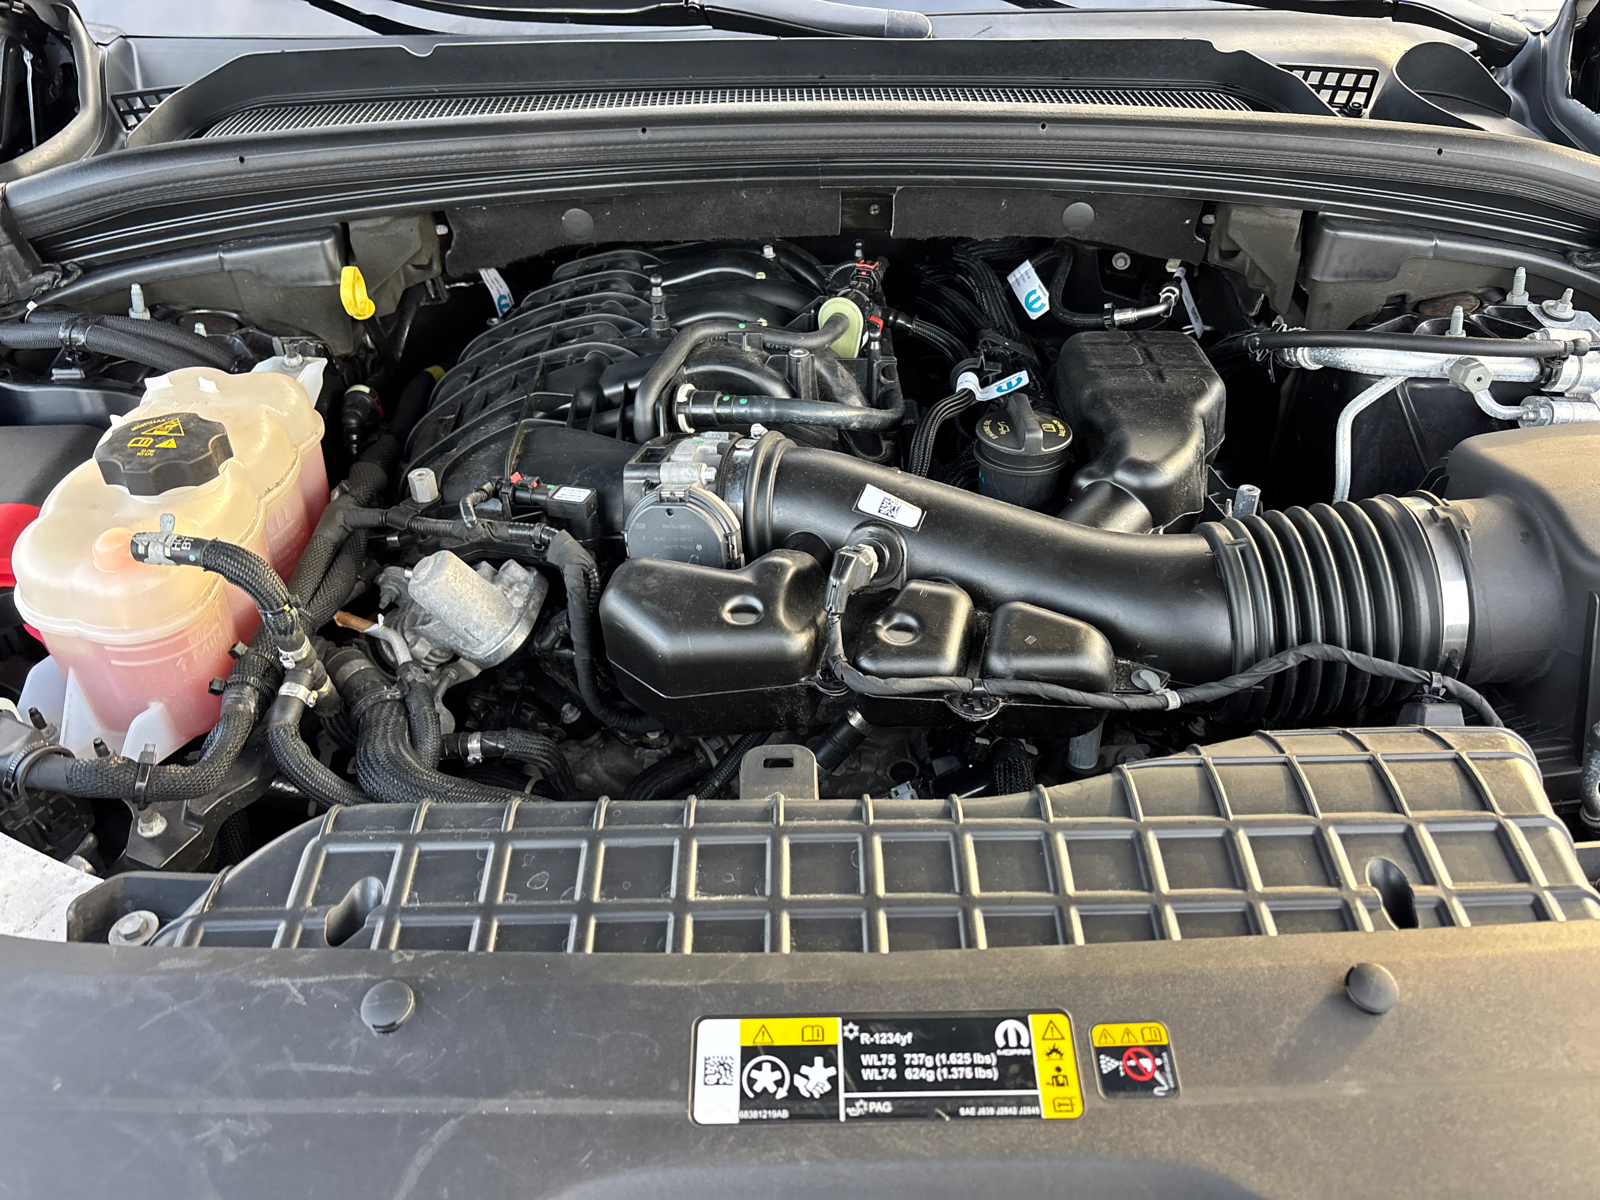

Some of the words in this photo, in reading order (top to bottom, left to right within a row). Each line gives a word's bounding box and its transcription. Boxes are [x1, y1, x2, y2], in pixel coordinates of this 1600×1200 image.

[860, 1032, 913, 1047] R-1234yf
[860, 1054, 896, 1066] WL75
[903, 1053, 934, 1068] 737g
[935, 1053, 972, 1067] (1.625
[973, 1052, 997, 1066] lbs)
[861, 1068, 897, 1081] WL74
[904, 1067, 935, 1082] 624g
[936, 1066, 972, 1082] (1.375
[974, 1066, 999, 1081] lbs)
[869, 1101, 893, 1113] PAG
[959, 1106, 976, 1116] SAE
